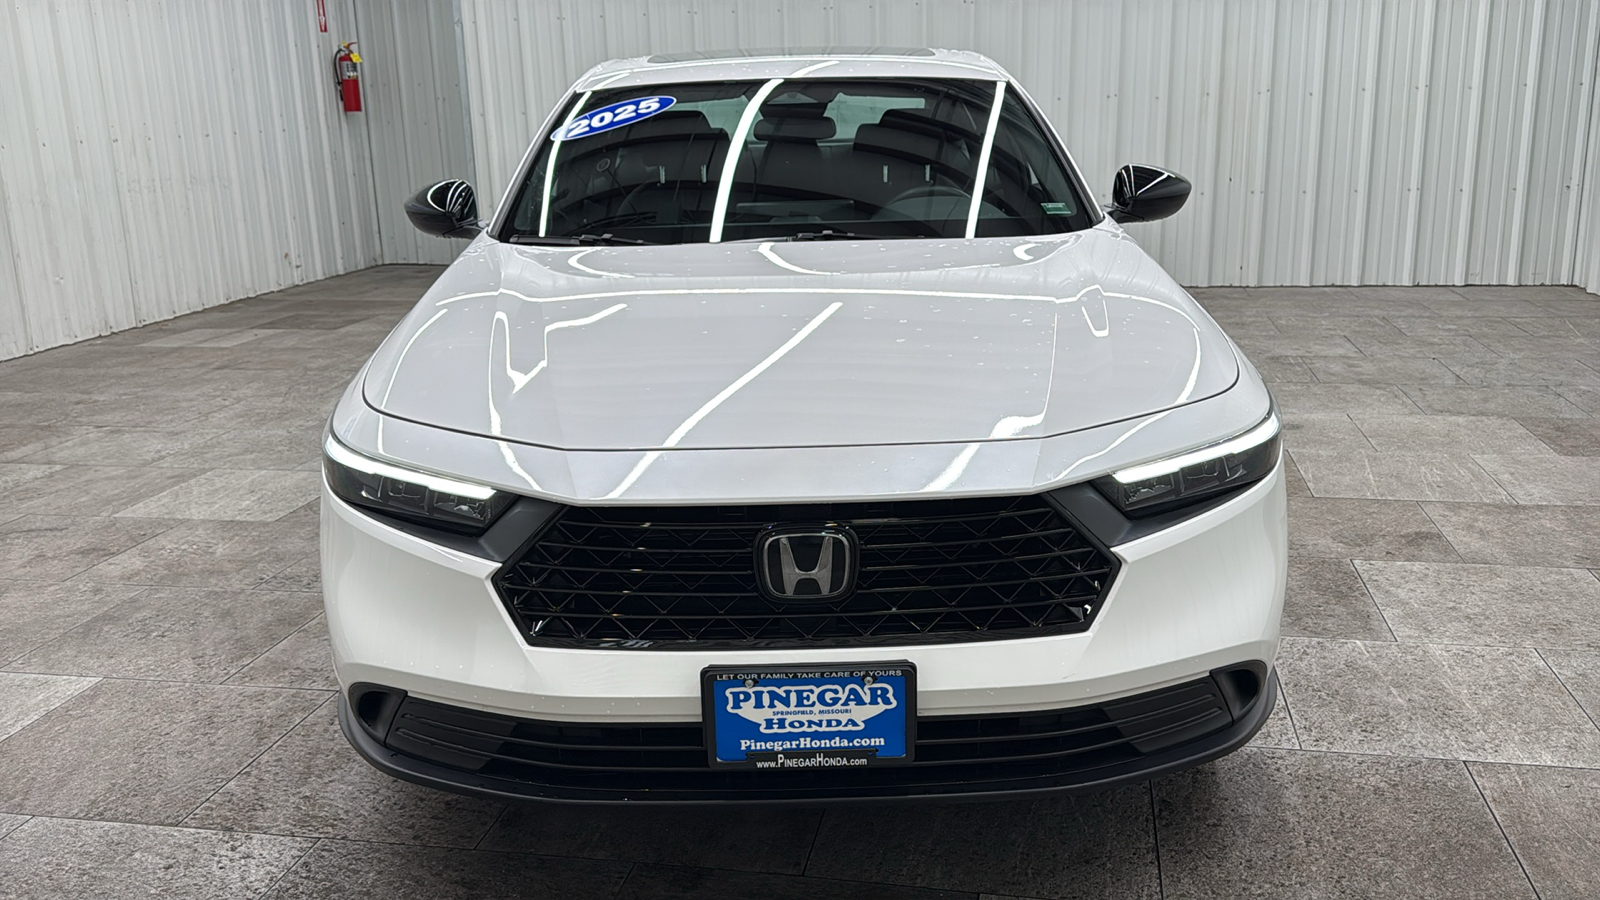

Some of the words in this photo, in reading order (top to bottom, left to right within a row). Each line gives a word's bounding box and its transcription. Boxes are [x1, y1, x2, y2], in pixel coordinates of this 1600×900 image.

[566, 98, 661, 138] 2025
[729, 686, 893, 710] PINEGAR
[763, 718, 861, 730] HONDA
[740, 736, 886, 751] PinegarHonda.com
